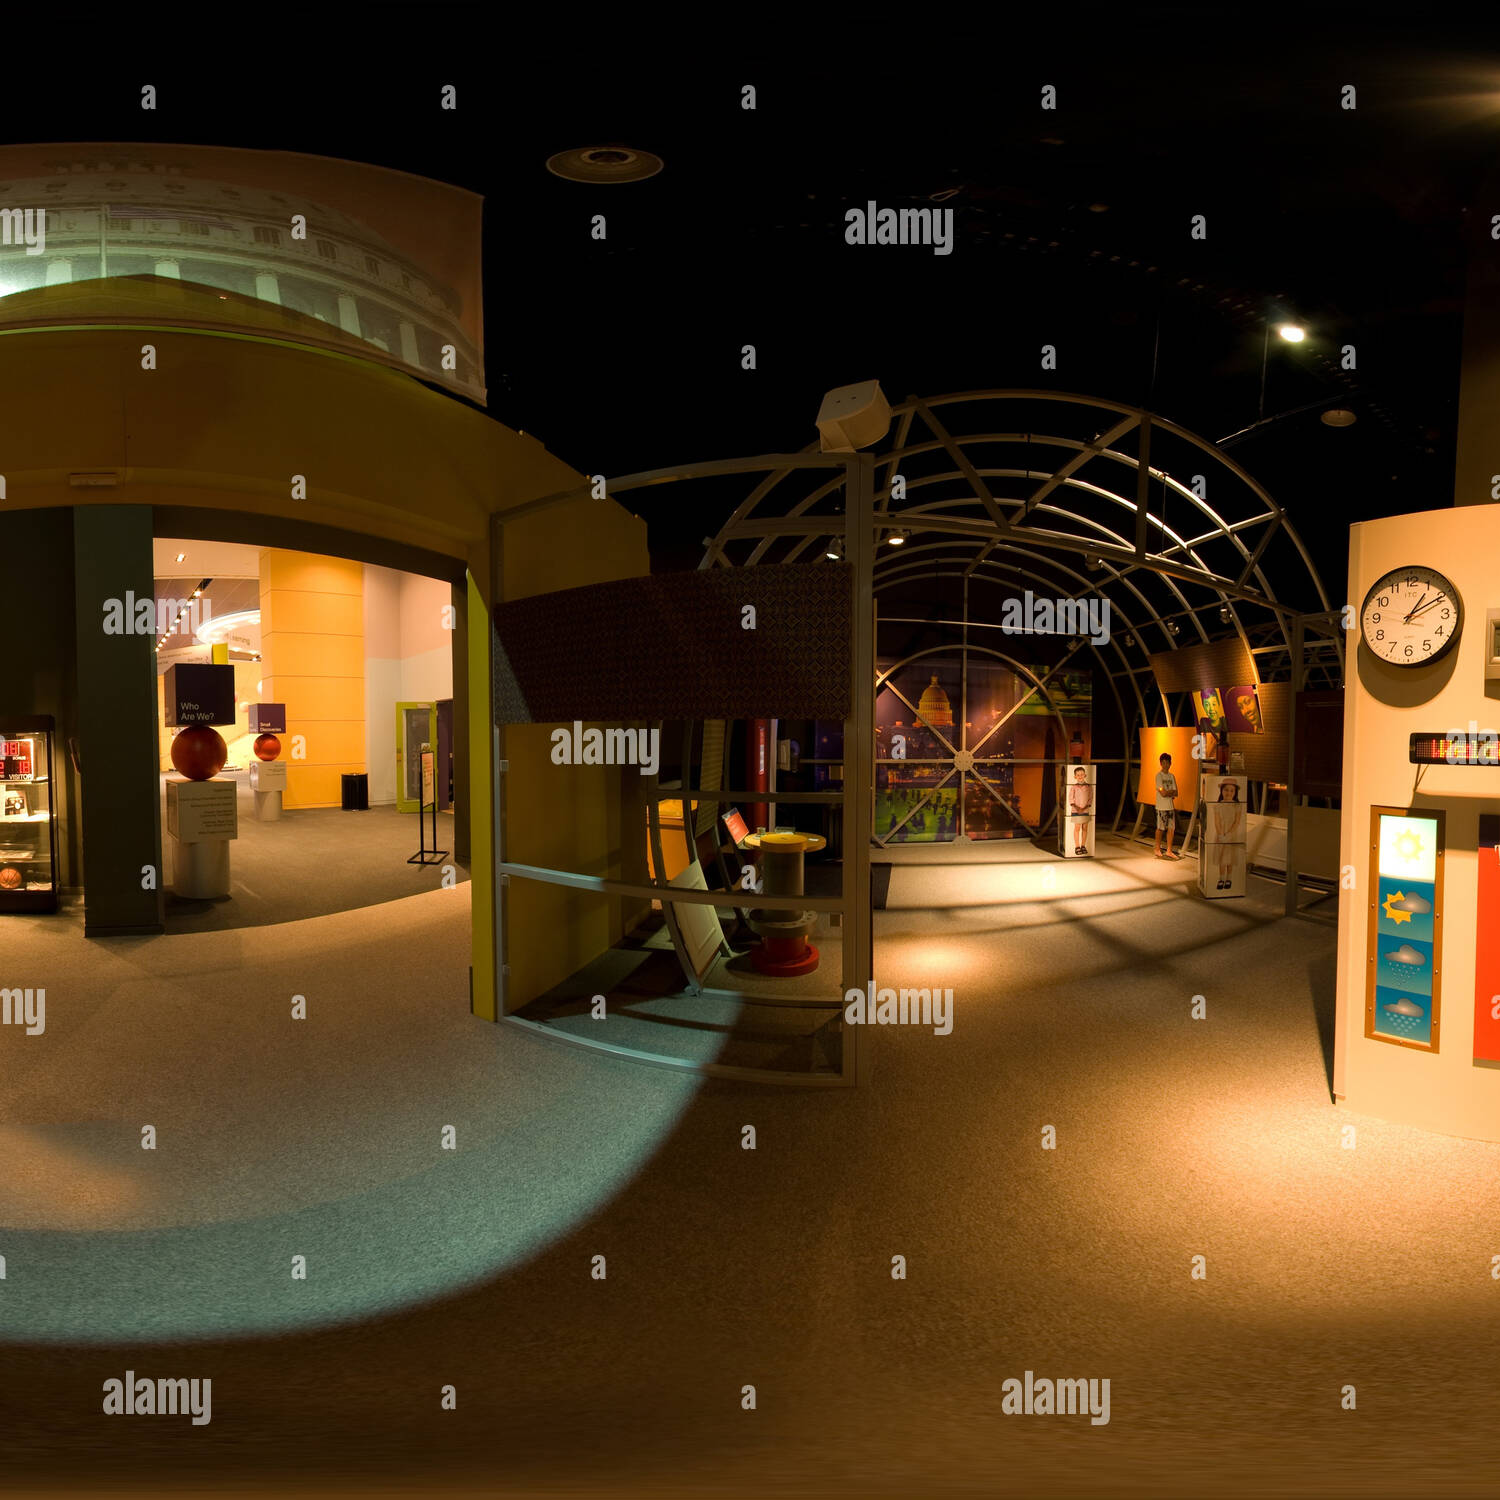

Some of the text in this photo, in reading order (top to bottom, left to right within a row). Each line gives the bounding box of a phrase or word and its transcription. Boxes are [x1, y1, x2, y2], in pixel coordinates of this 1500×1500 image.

[1406, 577, 1418, 587] 12
[1425, 581, 1430, 590] 1
[1391, 584, 1399, 593] 11
[1377, 597, 1389, 607] 10
[1437, 592, 1446, 602] 2
[1373, 613, 1380, 623] 9
[1441, 608, 1449, 619] 3
[1376, 630, 1384, 640] 8
[1435, 626, 1444, 636] 4
[1389, 642, 1397, 652] 7
[1405, 645, 1413, 656] 6
[1423, 640, 1431, 651] 5
[181, 702, 199, 710] Who
[181, 712, 214, 720] Are We?
